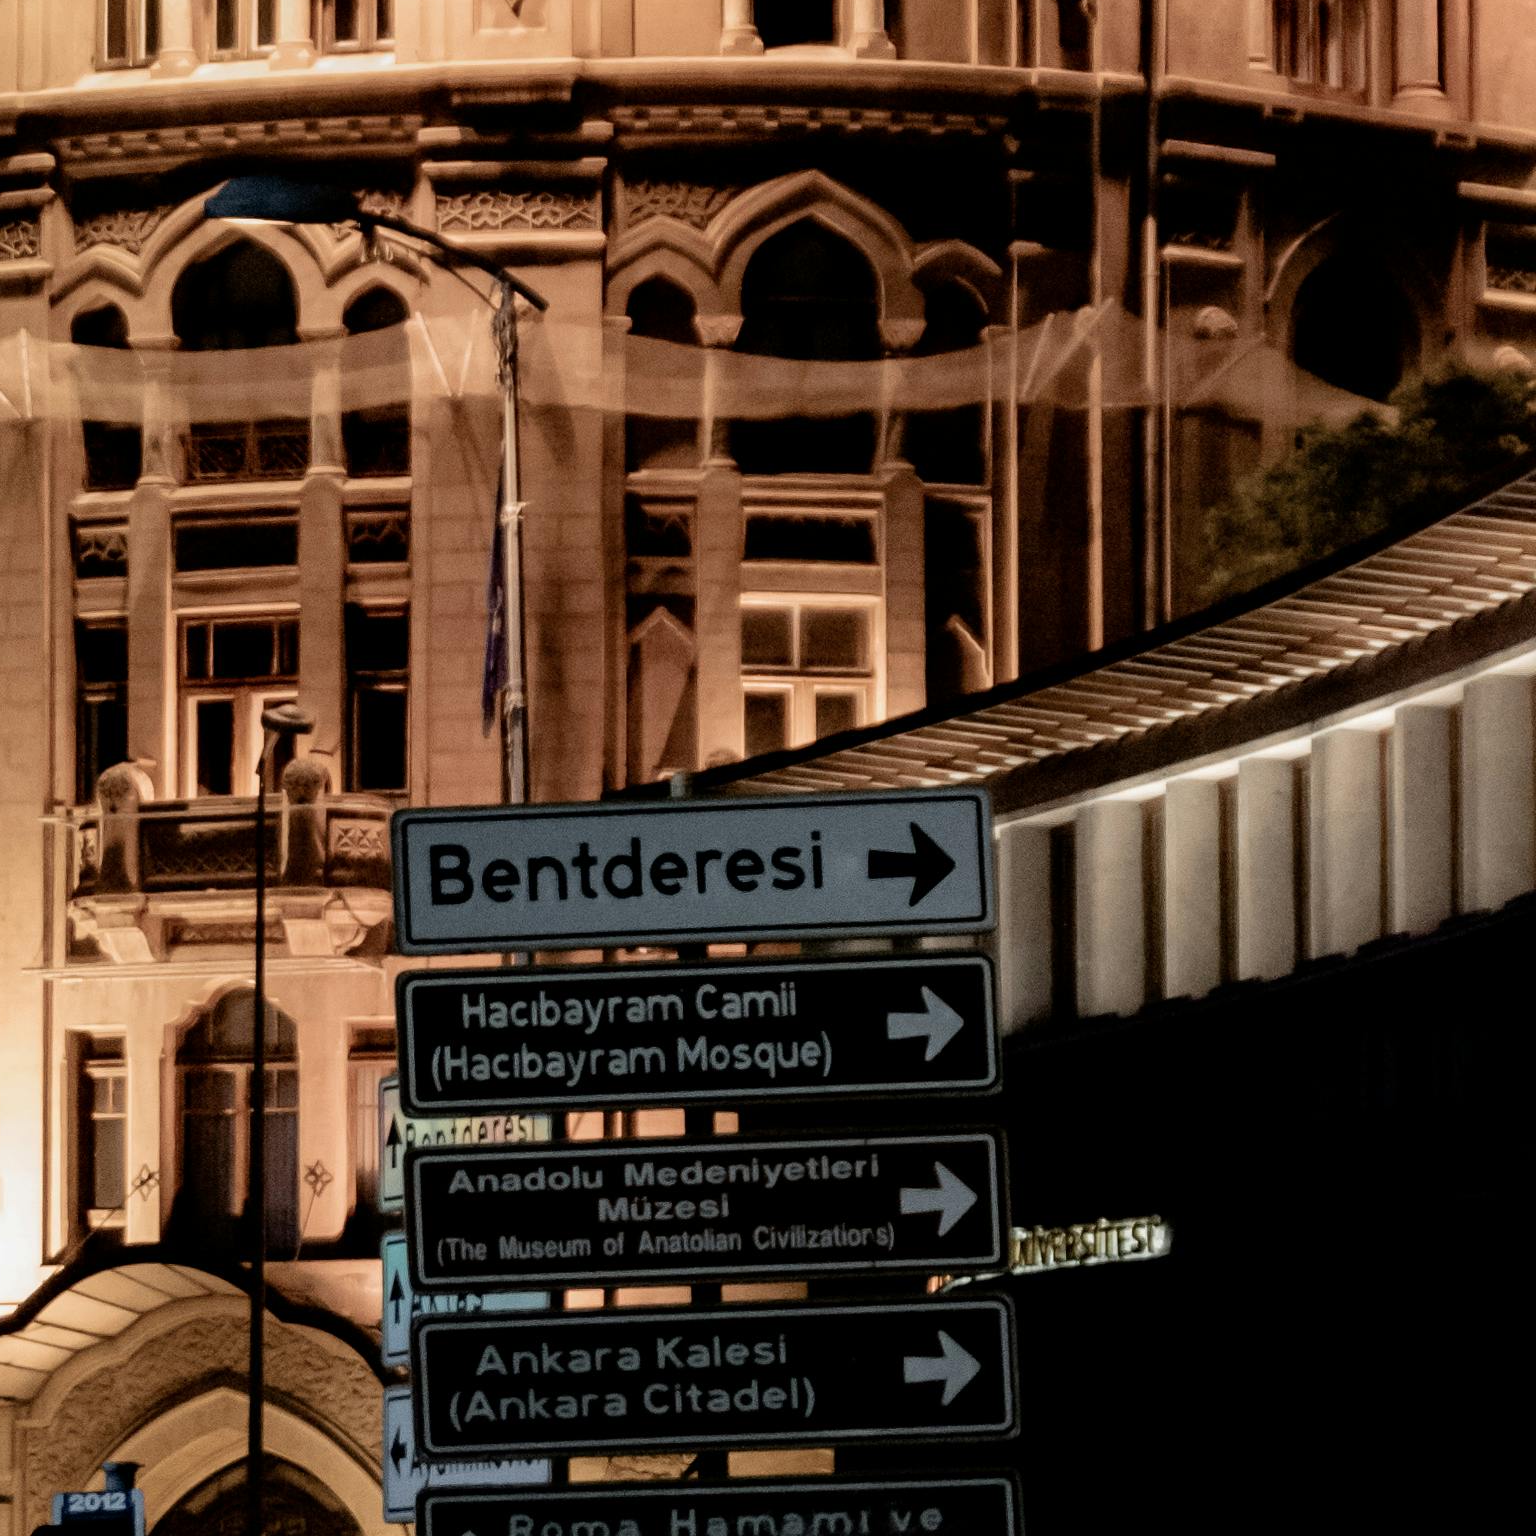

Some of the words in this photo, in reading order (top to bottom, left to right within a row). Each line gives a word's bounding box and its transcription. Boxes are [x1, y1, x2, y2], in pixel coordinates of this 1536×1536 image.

[427, 830, 824, 907] Bentderesi
[462, 990, 683, 1035] Hacıbayram
[695, 982, 797, 1020] Camii
[431, 1042, 666, 1091] (Hacıbayram
[677, 1031, 832, 1078] Mosque)
[448, 1166, 603, 1194] Anadolu
[624, 1154, 879, 1188] Medeniyetleri
[598, 1194, 729, 1222] Müzesi
[437, 1237, 487, 1265] (The
[499, 1235, 592, 1260] Museum
[603, 1232, 625, 1256] of
[638, 1228, 742, 1254] Anatolian
[476, 1343, 641, 1376] Ankara
[657, 1336, 787, 1369] Kalesi
[449, 1388, 627, 1432] (Ankara
[644, 1377, 815, 1417] Citadel)
[68, 1492, 126, 1513] 2012
[891, 1508, 942, 1533] ve
